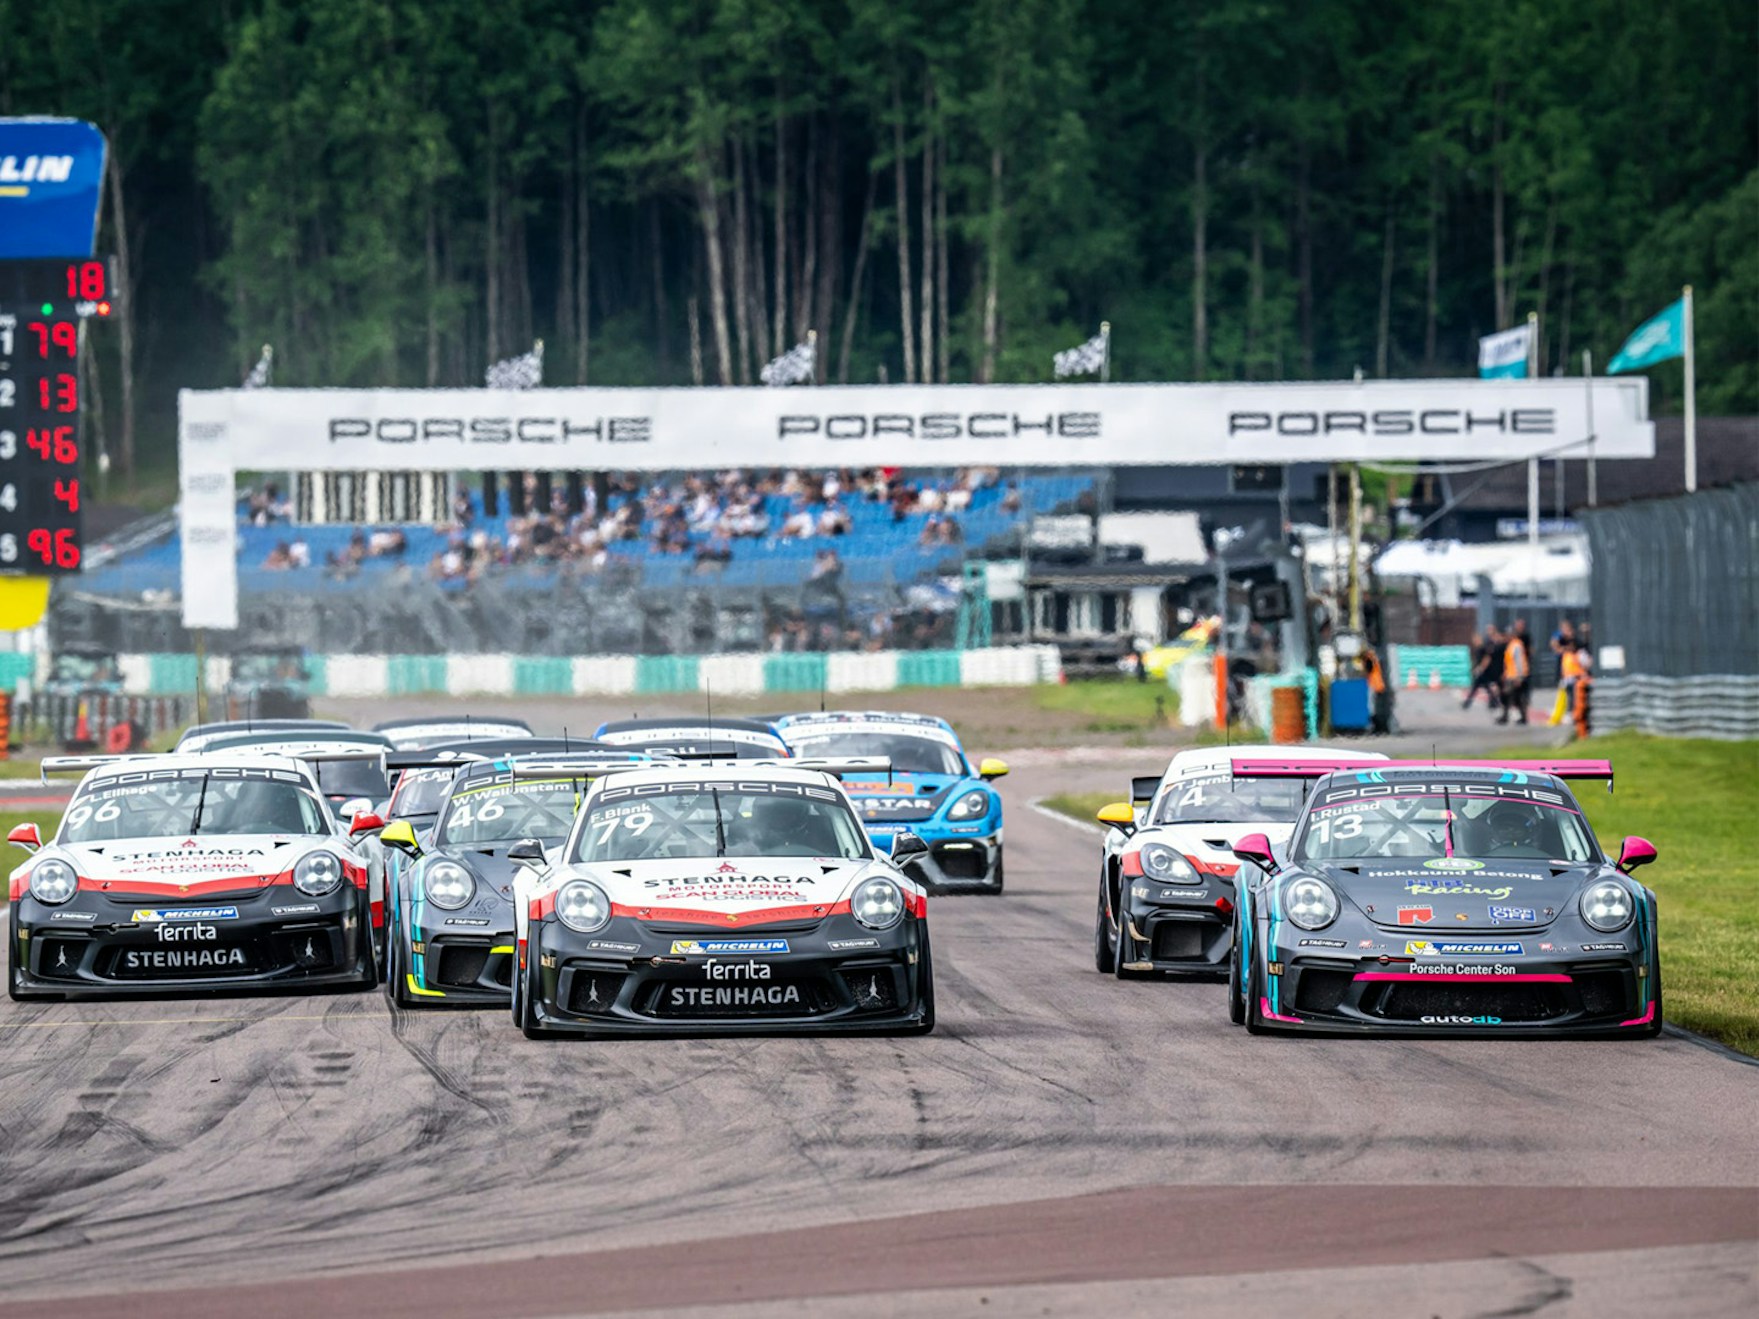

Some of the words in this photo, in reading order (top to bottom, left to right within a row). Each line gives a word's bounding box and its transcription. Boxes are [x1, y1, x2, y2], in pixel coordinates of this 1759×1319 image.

[67, 262, 105, 300] 18
[27, 321, 77, 358] 79
[39, 373, 78, 413] 13
[328, 416, 652, 443] PORSCHE
[778, 412, 1101, 439] PORSCHE
[1229, 409, 1556, 436] PORSCHE
[26, 426, 79, 464] 46
[54, 477, 80, 513] 4
[27, 528, 81, 569] 96
[88, 768, 301, 792] PORSCHE
[600, 782, 838, 801] PORSCHE
[1179, 786, 1207, 807] 4
[1326, 784, 1563, 805] PORSCHE
[67, 799, 122, 830] 96
[447, 798, 505, 829] 46
[590, 803, 651, 823] F.Blank
[1310, 800, 1381, 822] I.Rustad
[592, 812, 654, 846] 79
[1310, 813, 1364, 844] 13
[113, 849, 265, 862] STENHAGA
[644, 875, 816, 888] STENHAGA
[1474, 870, 1544, 880] Betong
[656, 891, 717, 900] SCAN
[723, 889, 807, 898] GLOBAL
[668, 884, 793, 892] MOTORSPORT
[1404, 884, 1514, 900] Racing
[164, 909, 234, 918] MICHELIN
[154, 922, 217, 941] ferrita
[707, 942, 785, 950] MICHELIN
[1441, 944, 1520, 952] MICHELIN
[127, 948, 245, 967] STENHAGA
[702, 959, 771, 979] ferrita
[1410, 963, 1454, 975] Porsche
[1456, 963, 1493, 975] Center
[1494, 963, 1516, 975] Son
[671, 984, 800, 1005] STENHAGA
